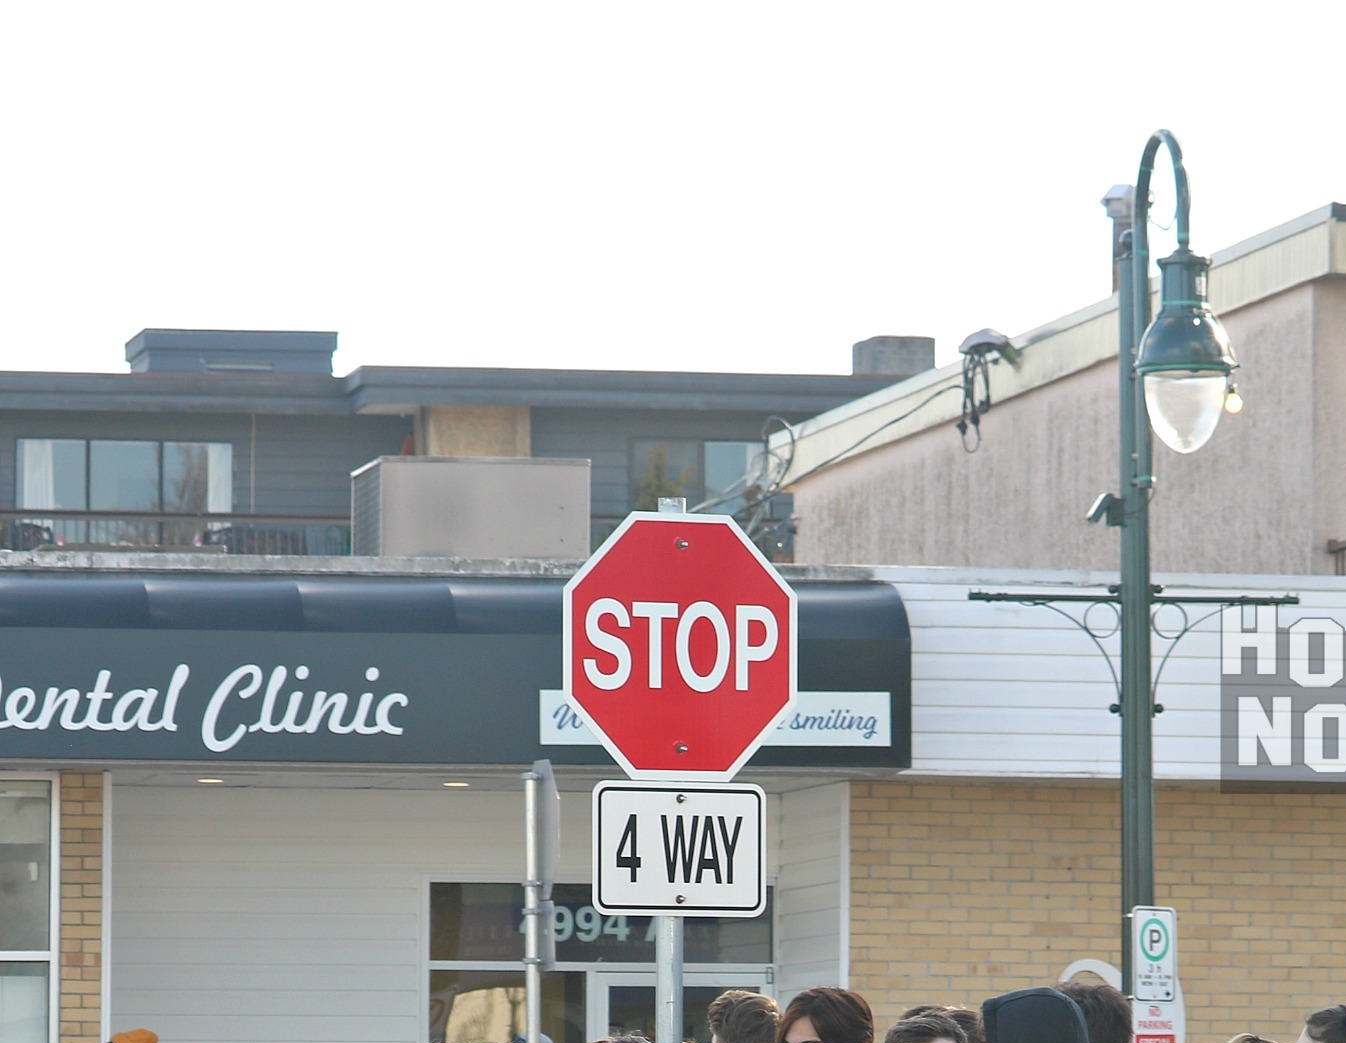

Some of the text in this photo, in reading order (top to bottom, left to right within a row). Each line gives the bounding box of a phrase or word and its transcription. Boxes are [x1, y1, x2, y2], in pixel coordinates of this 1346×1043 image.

[583, 597, 779, 693] STOP
[0, 663, 409, 753] ental Clinic
[788, 710, 878, 739] smiling
[616, 814, 744, 885] 4 WAY
[519, 905, 631, 942] 994
[1149, 929, 1162, 951] P
[1138, 1020, 1173, 1030] PARKING
[1148, 1008, 1162, 1017] NO
